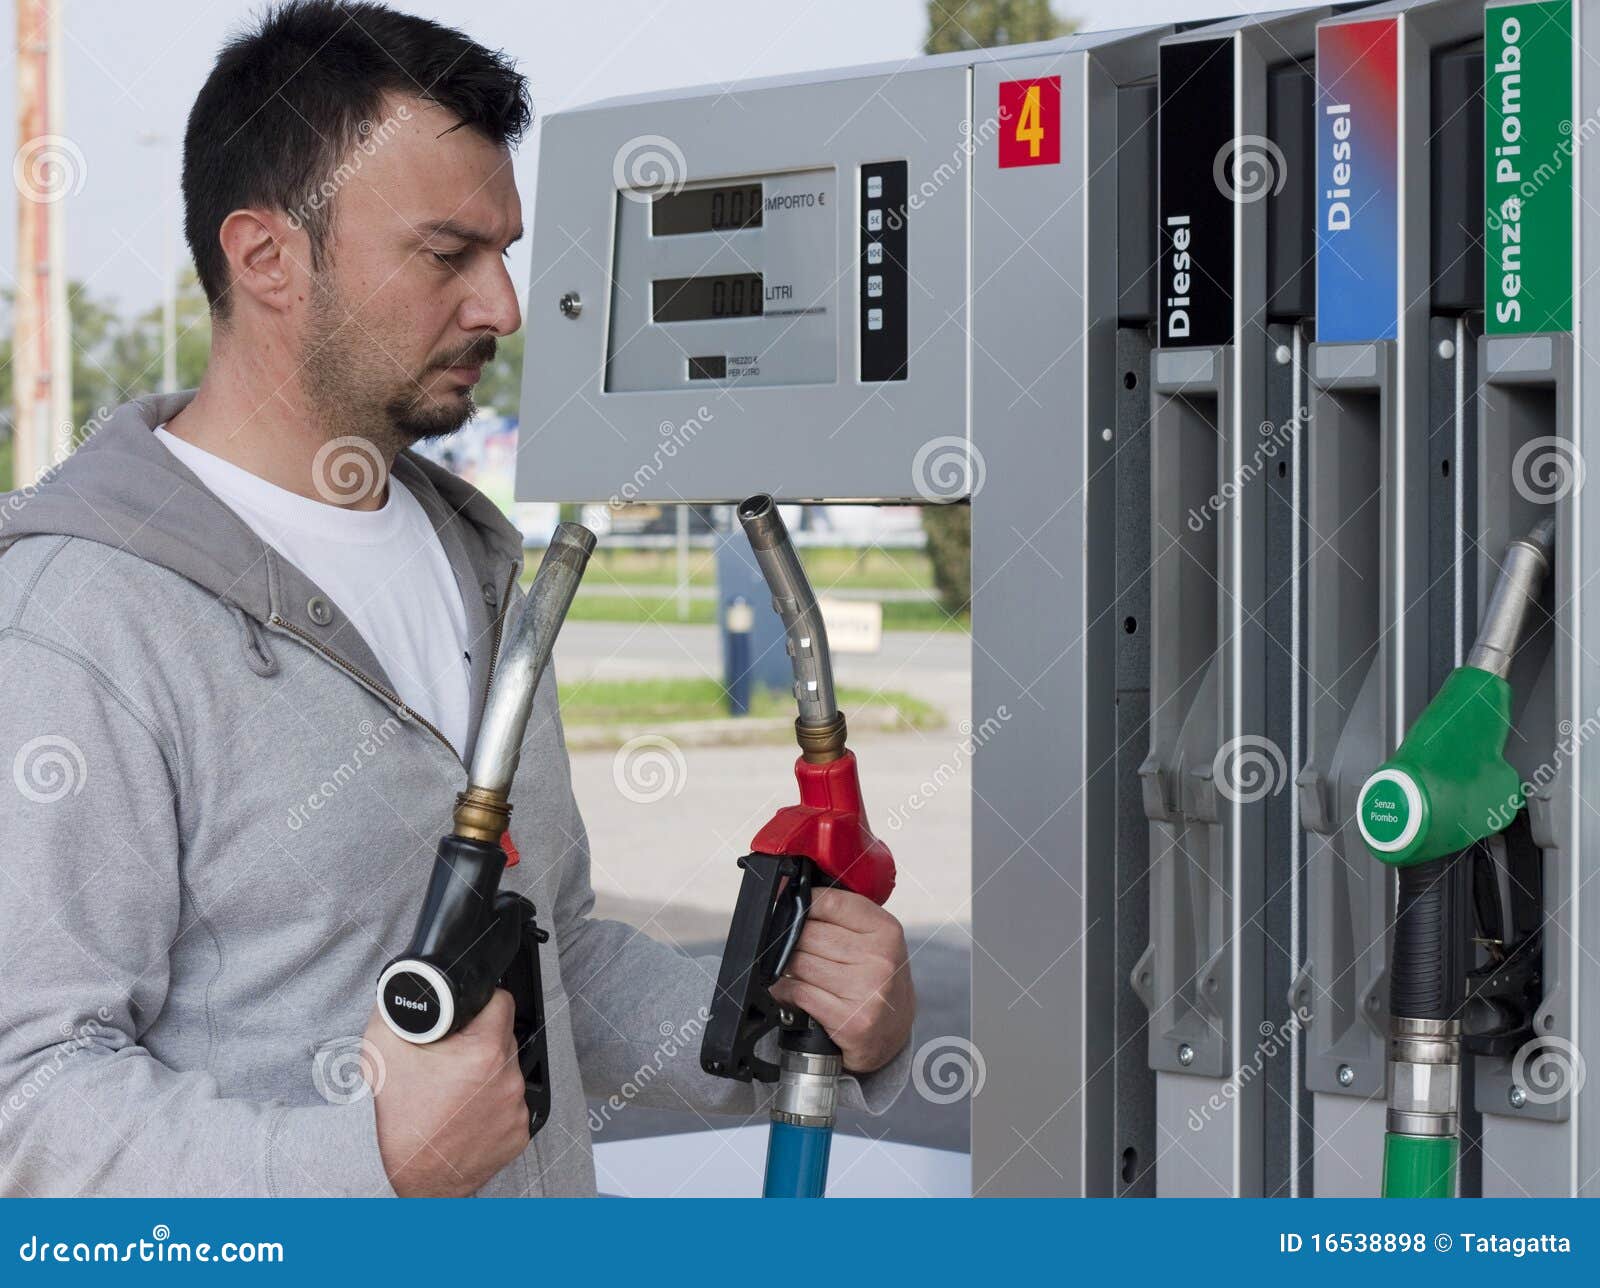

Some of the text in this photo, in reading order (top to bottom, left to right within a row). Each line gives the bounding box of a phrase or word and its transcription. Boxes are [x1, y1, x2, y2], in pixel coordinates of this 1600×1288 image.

[1016, 86, 1044, 157] 4
[1327, 104, 1350, 231] Diesel
[1495, 17, 1521, 324] Senza Piombo
[765, 193, 814, 211] IMPORTO
[1167, 215, 1190, 338] Diesel
[765, 284, 793, 300] LITRI
[1375, 798, 1395, 809] Senza
[1371, 811, 1398, 823] Piombo
[395, 995, 427, 1012] Diesel
